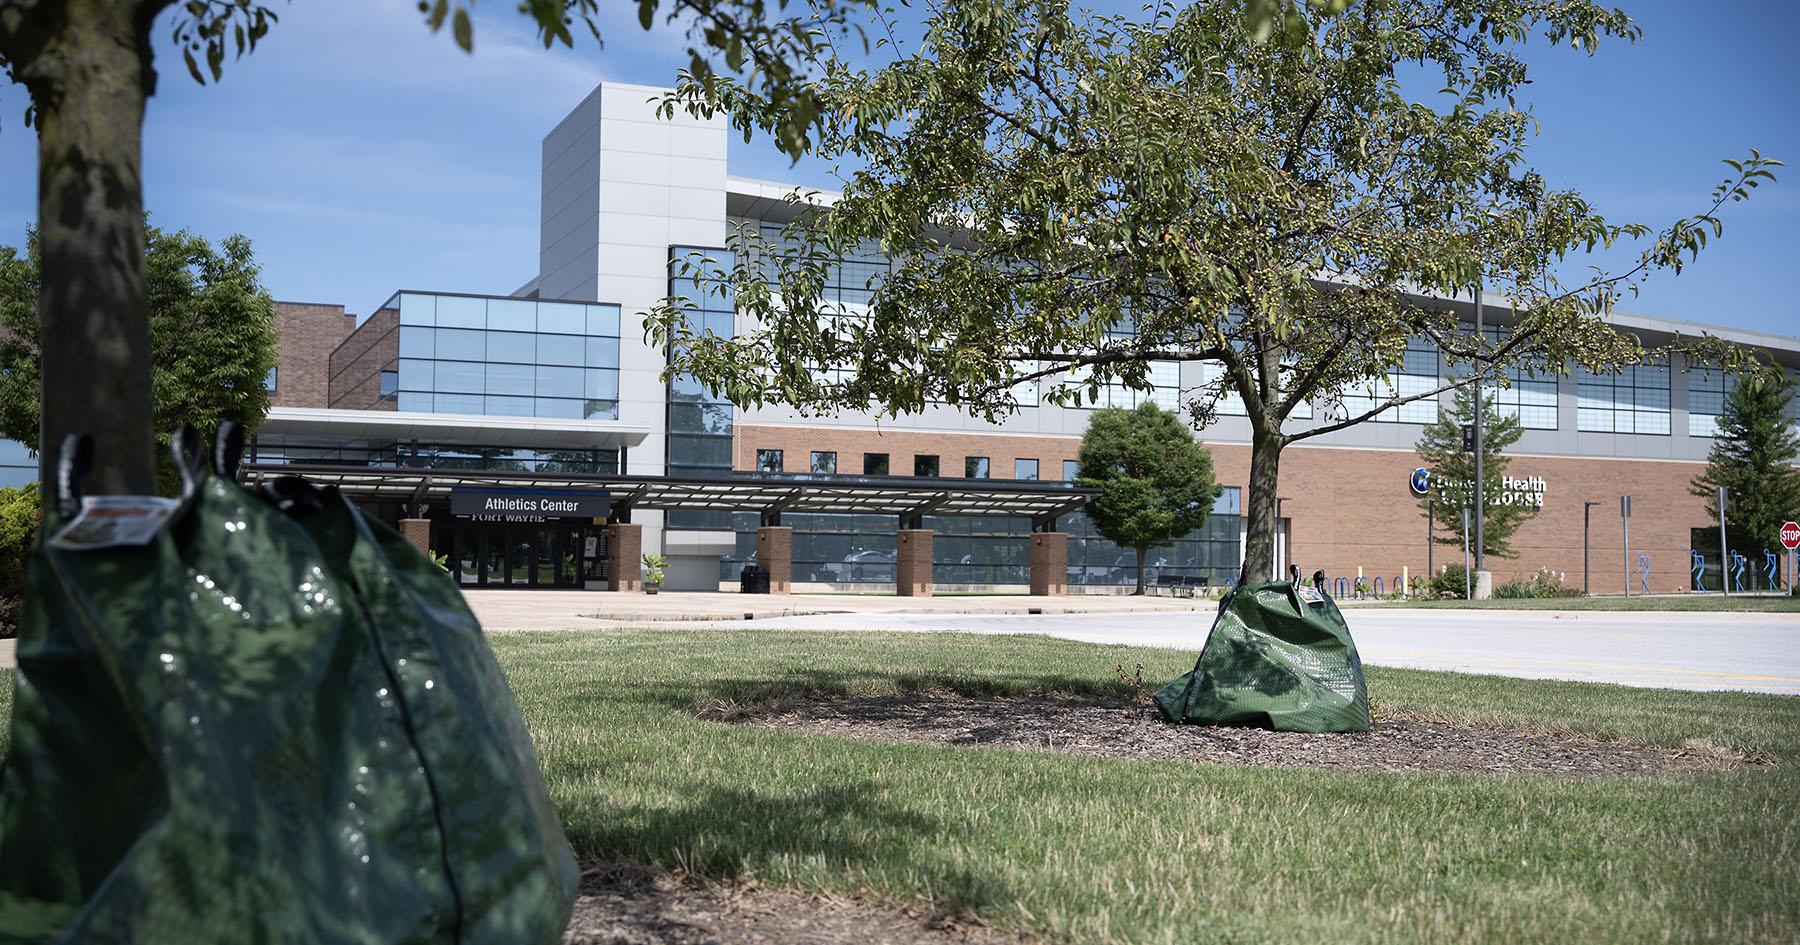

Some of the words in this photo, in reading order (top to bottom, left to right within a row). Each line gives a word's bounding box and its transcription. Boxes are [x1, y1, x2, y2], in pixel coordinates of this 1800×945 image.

[1502, 476, 1547, 491] Health
[485, 498, 537, 511] Athletics
[541, 499, 579, 511] Center
[1782, 530, 1800, 541] STOP
